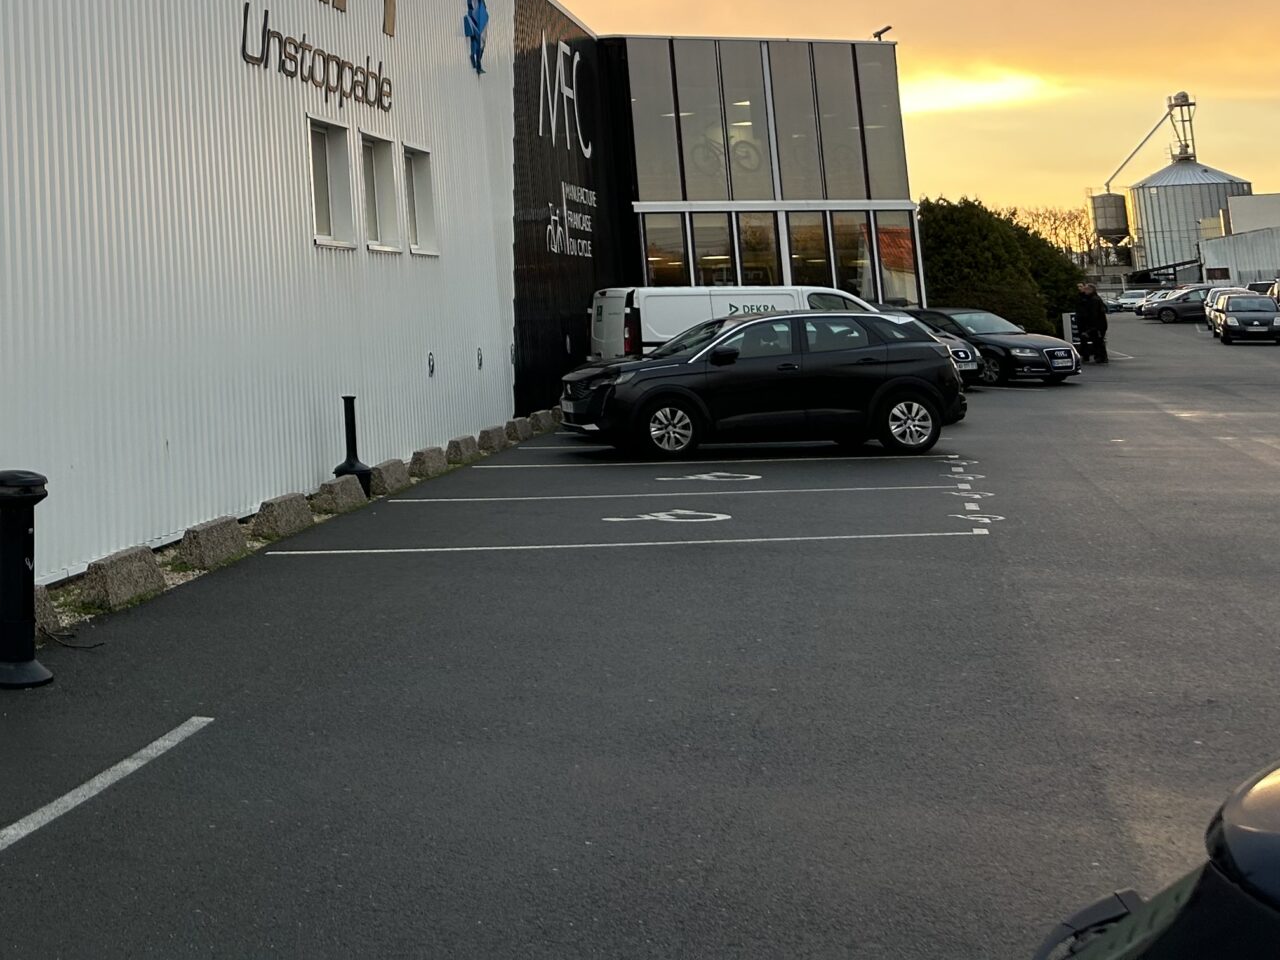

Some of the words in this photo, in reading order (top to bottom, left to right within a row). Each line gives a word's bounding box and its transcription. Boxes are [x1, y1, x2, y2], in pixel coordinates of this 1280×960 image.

[242, 2, 392, 112] Unstoppable
[539, 29, 592, 159] MFC
[743, 304, 777, 315] DEKRA
